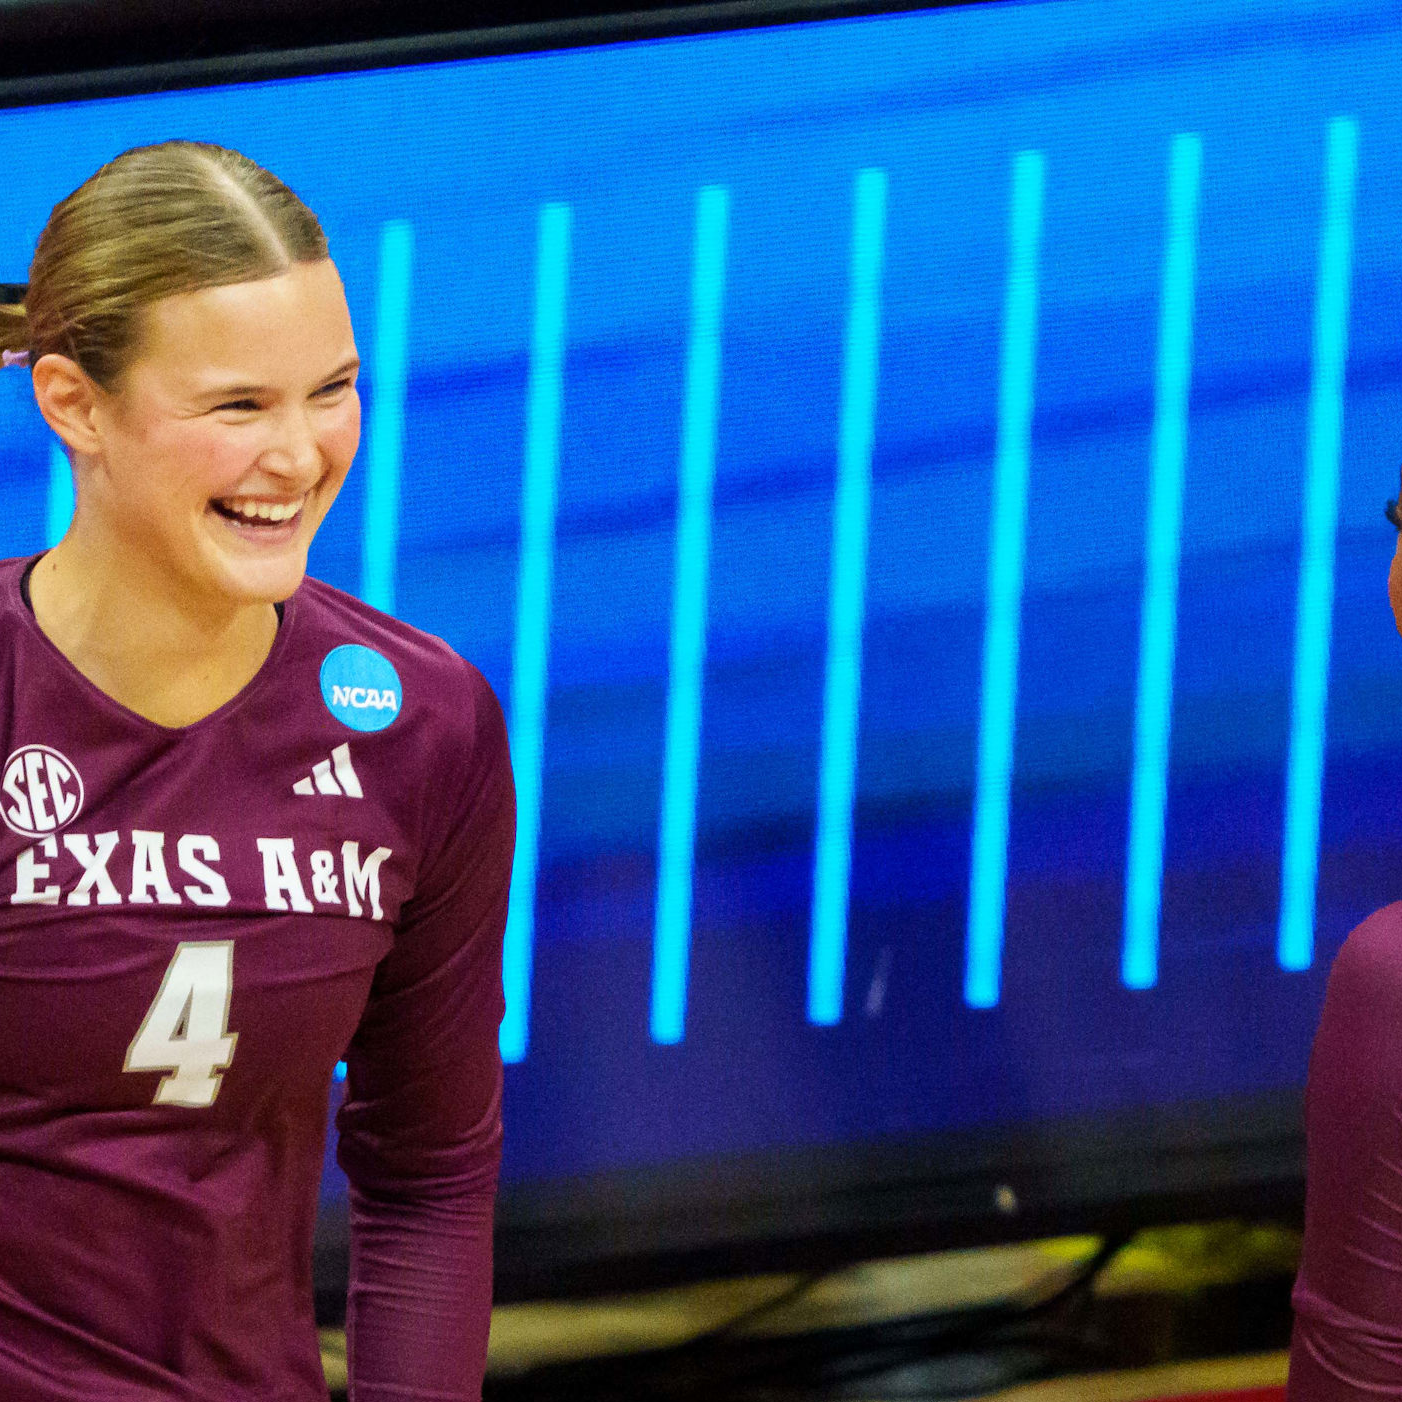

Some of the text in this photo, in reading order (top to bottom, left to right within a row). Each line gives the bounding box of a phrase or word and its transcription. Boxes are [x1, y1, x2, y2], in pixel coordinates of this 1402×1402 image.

[332, 684, 397, 711] NCAA
[2, 751, 78, 832] SEC
[256, 838, 393, 920] A&M
[122, 939, 239, 1108] 4
